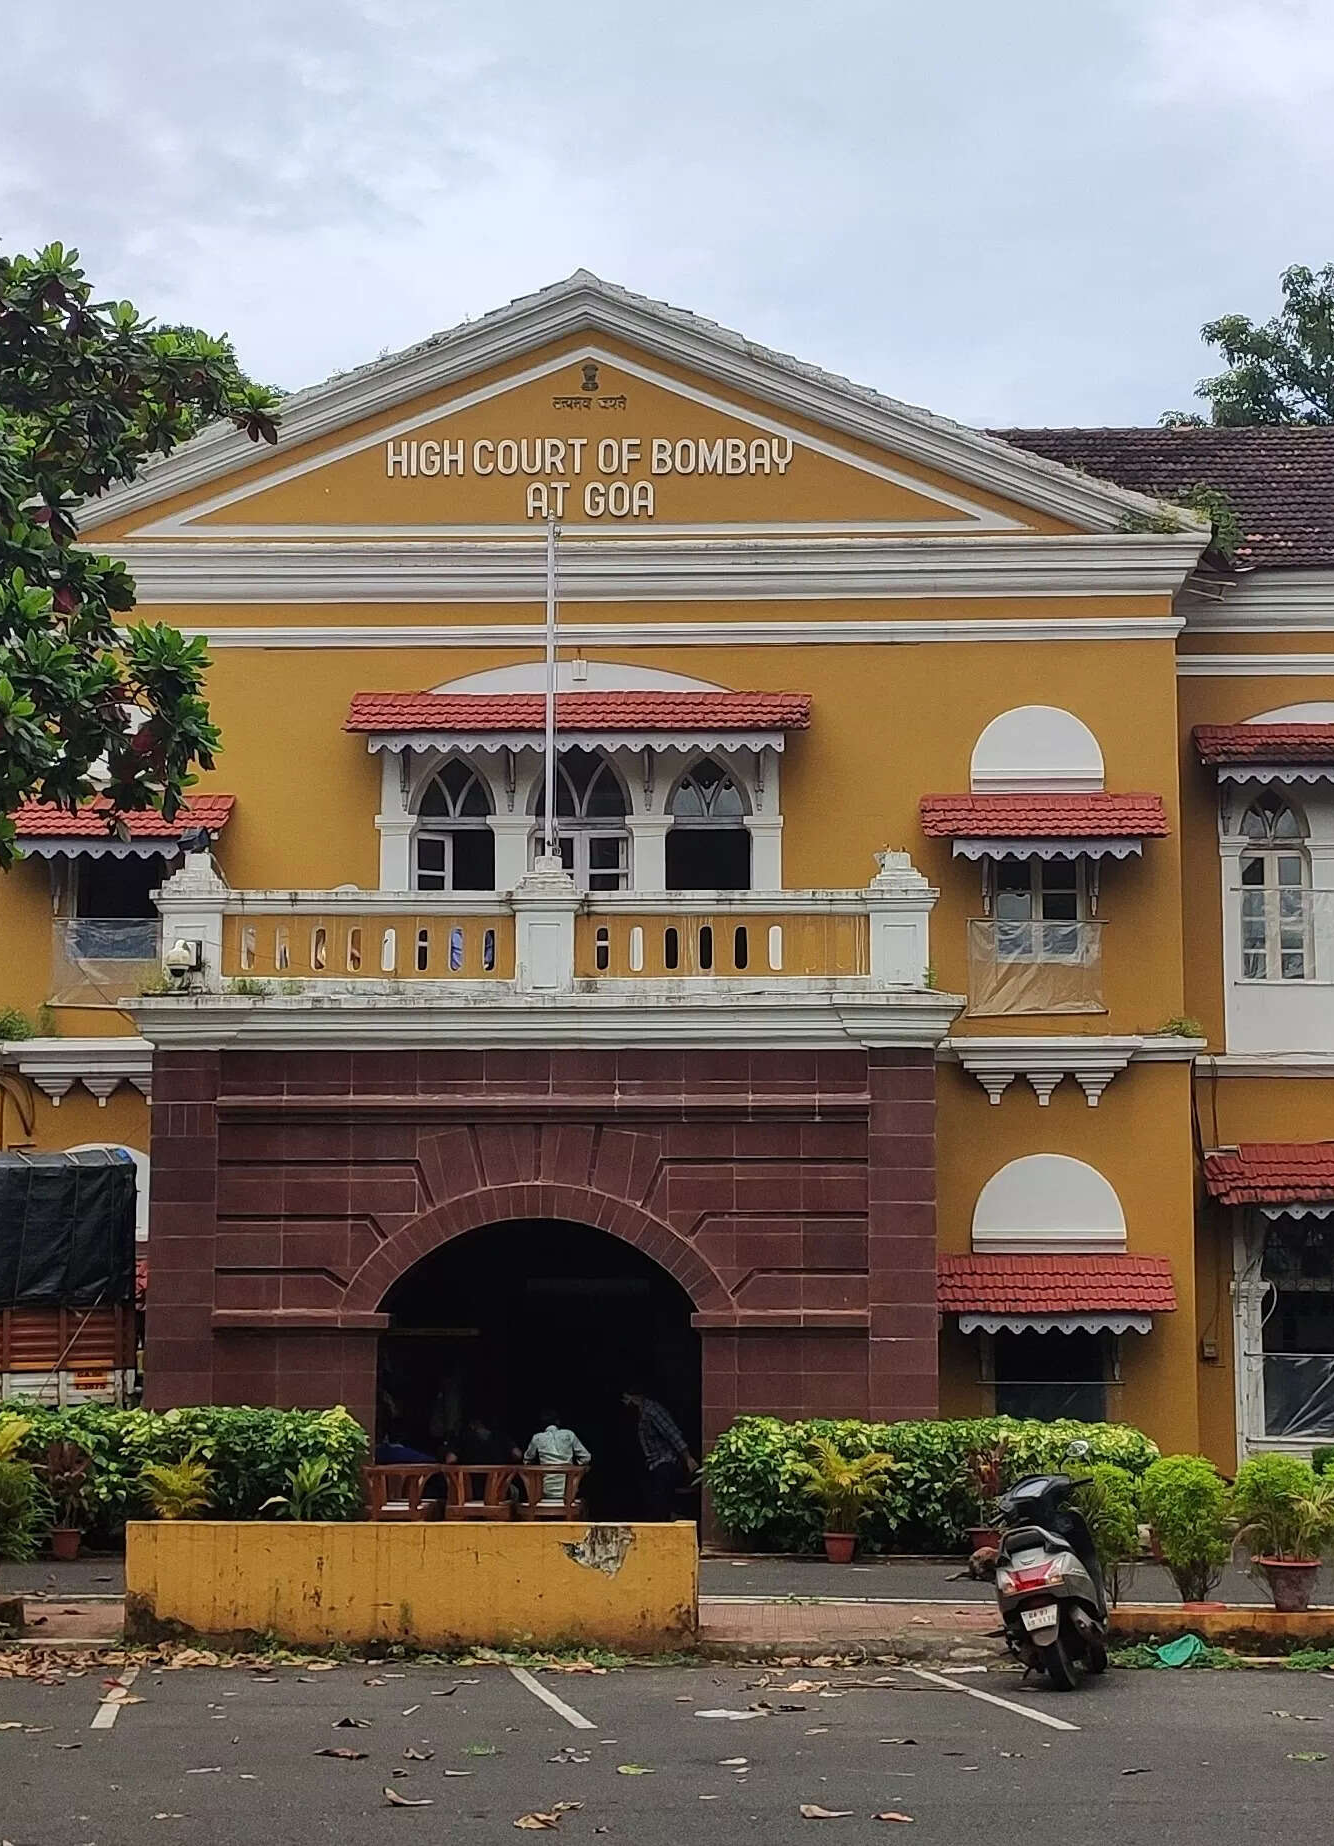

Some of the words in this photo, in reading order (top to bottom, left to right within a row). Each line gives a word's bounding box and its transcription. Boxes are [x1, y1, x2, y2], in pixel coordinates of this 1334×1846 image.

[386, 439, 465, 477] HIGH
[472, 438, 588, 476] COURT
[597, 438, 641, 475] OF
[651, 438, 794, 475] BOMBAY
[526, 481, 571, 518] AT
[583, 481, 654, 517] GOA
